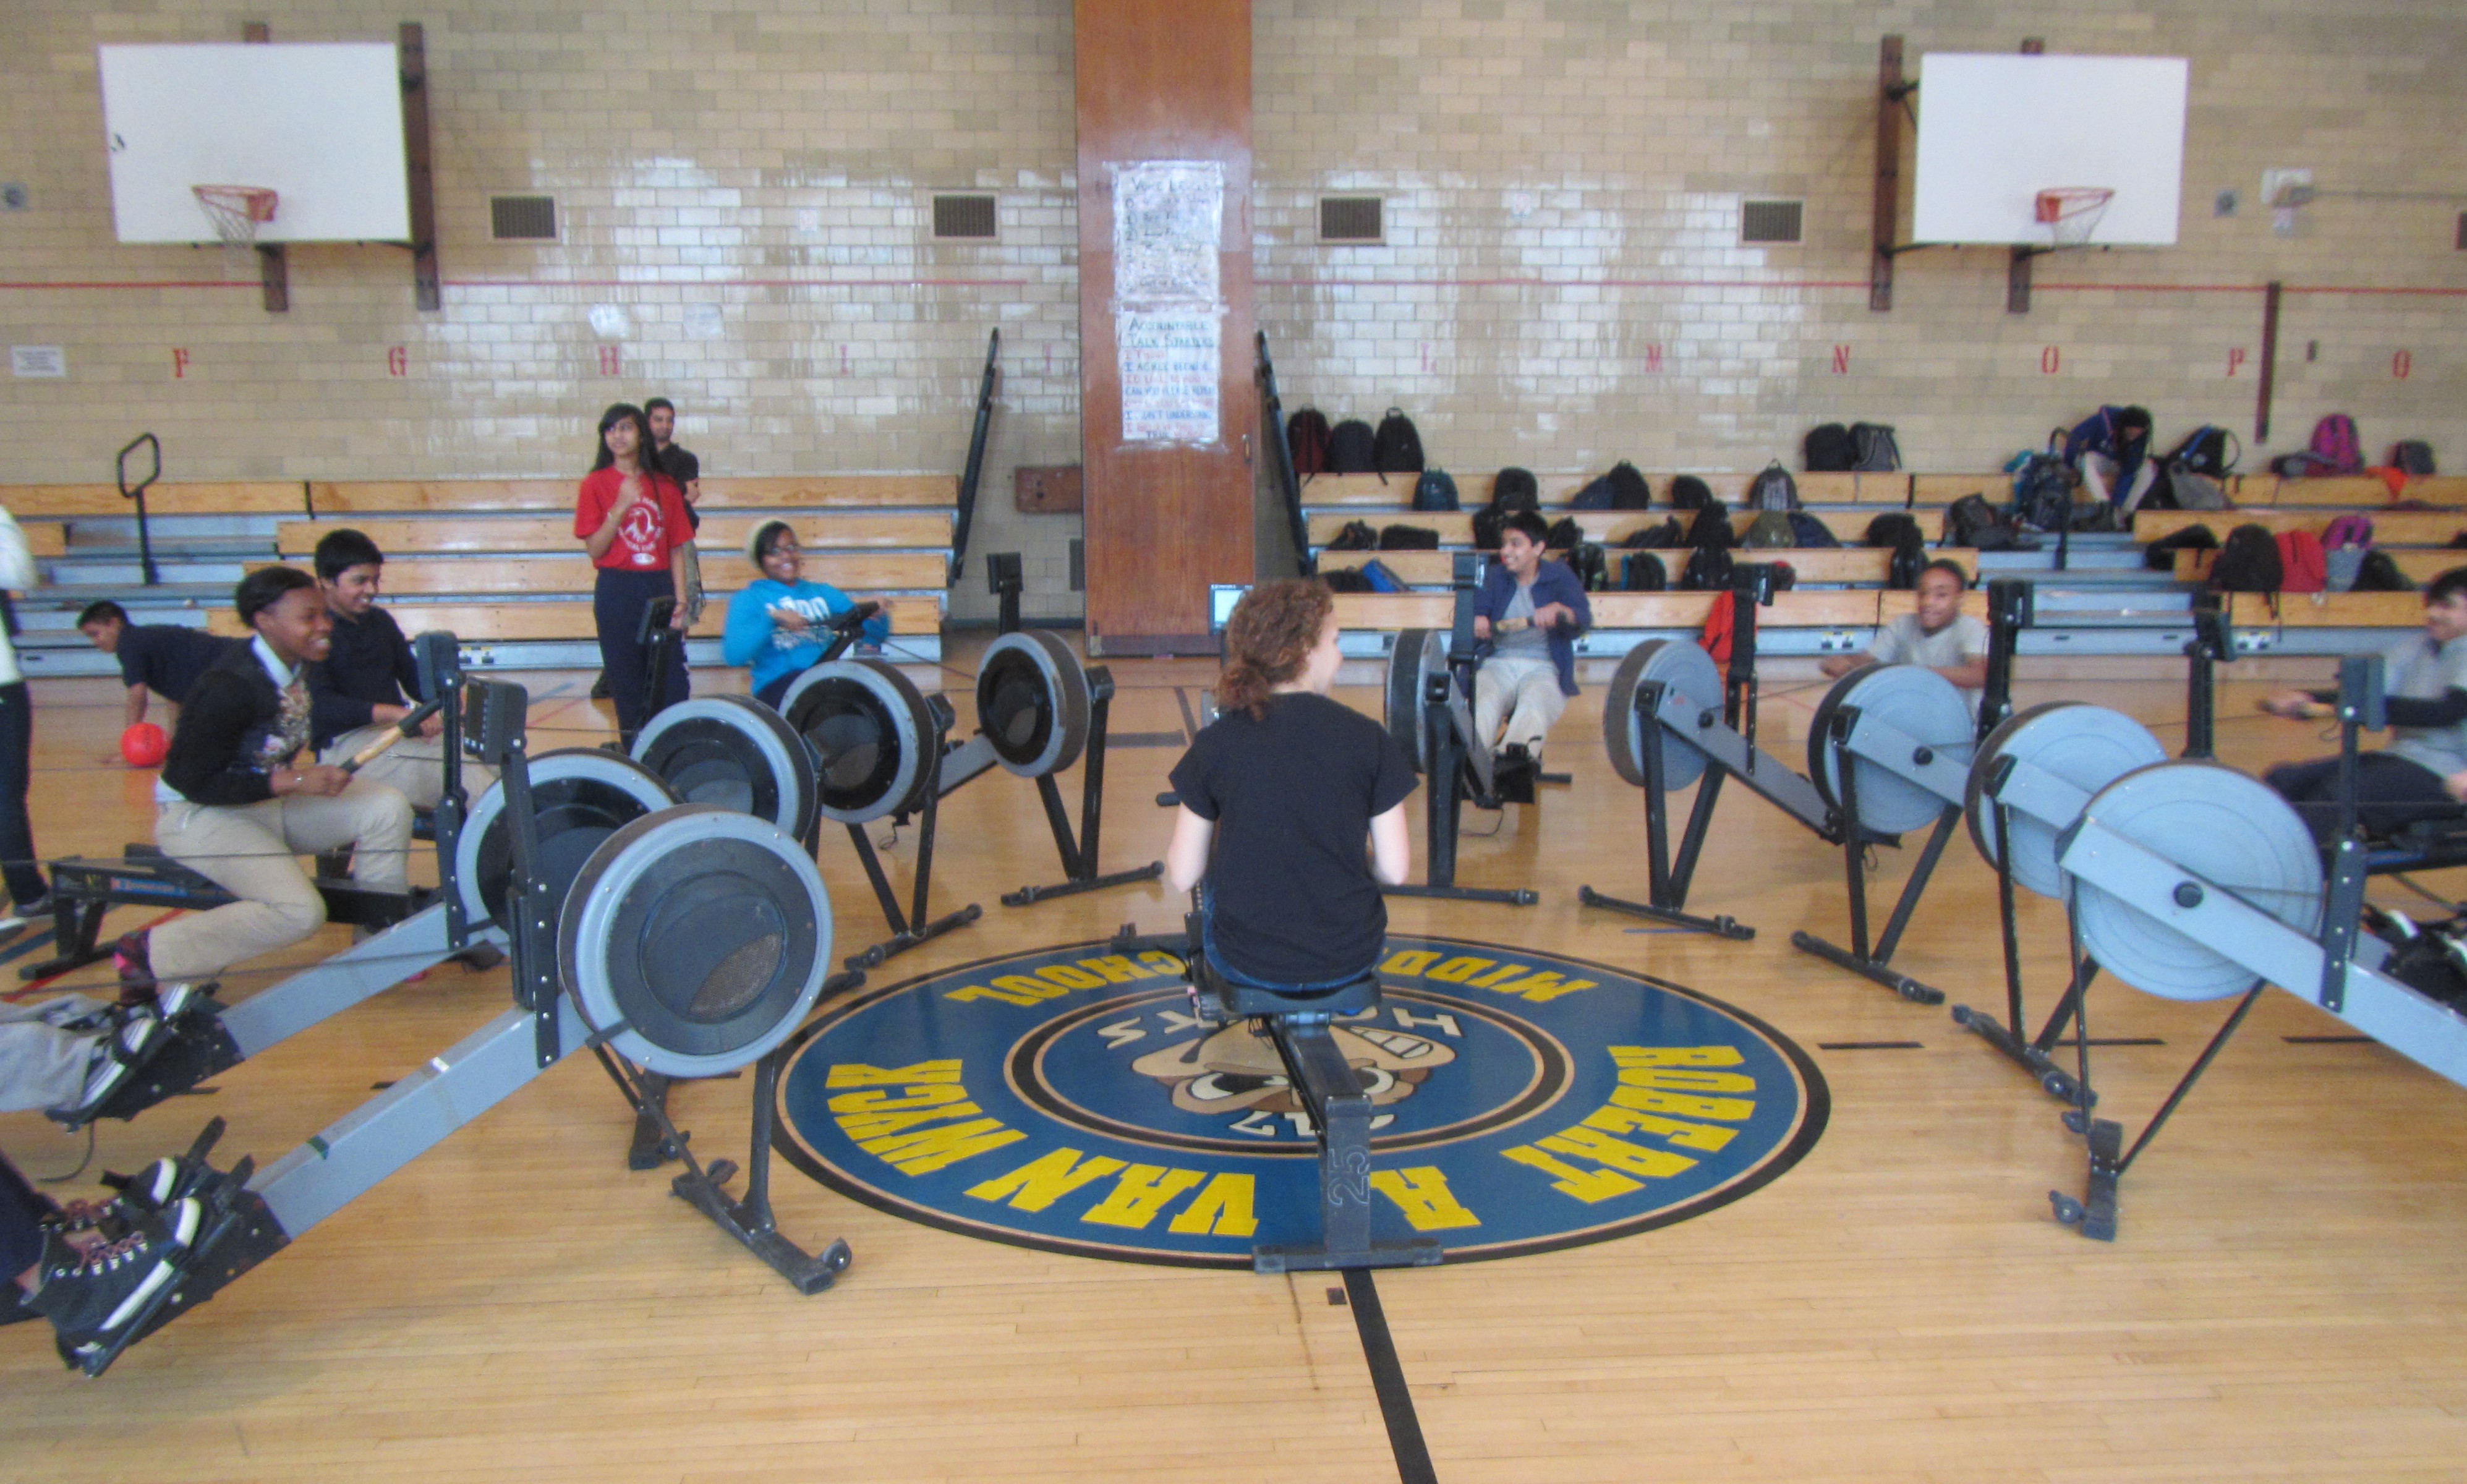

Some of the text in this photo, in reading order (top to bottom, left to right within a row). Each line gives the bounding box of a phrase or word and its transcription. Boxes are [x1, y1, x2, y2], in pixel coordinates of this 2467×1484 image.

[599, 345, 620, 375] H
[1832, 344, 1850, 374] N
[2226, 348, 2246, 377] P
[944, 948, 1599, 1007] MIDD CHOOL
[825, 1046, 1757, 1237] ROBERT A VAN WYCK
[1327, 1144, 1371, 1206] 25
